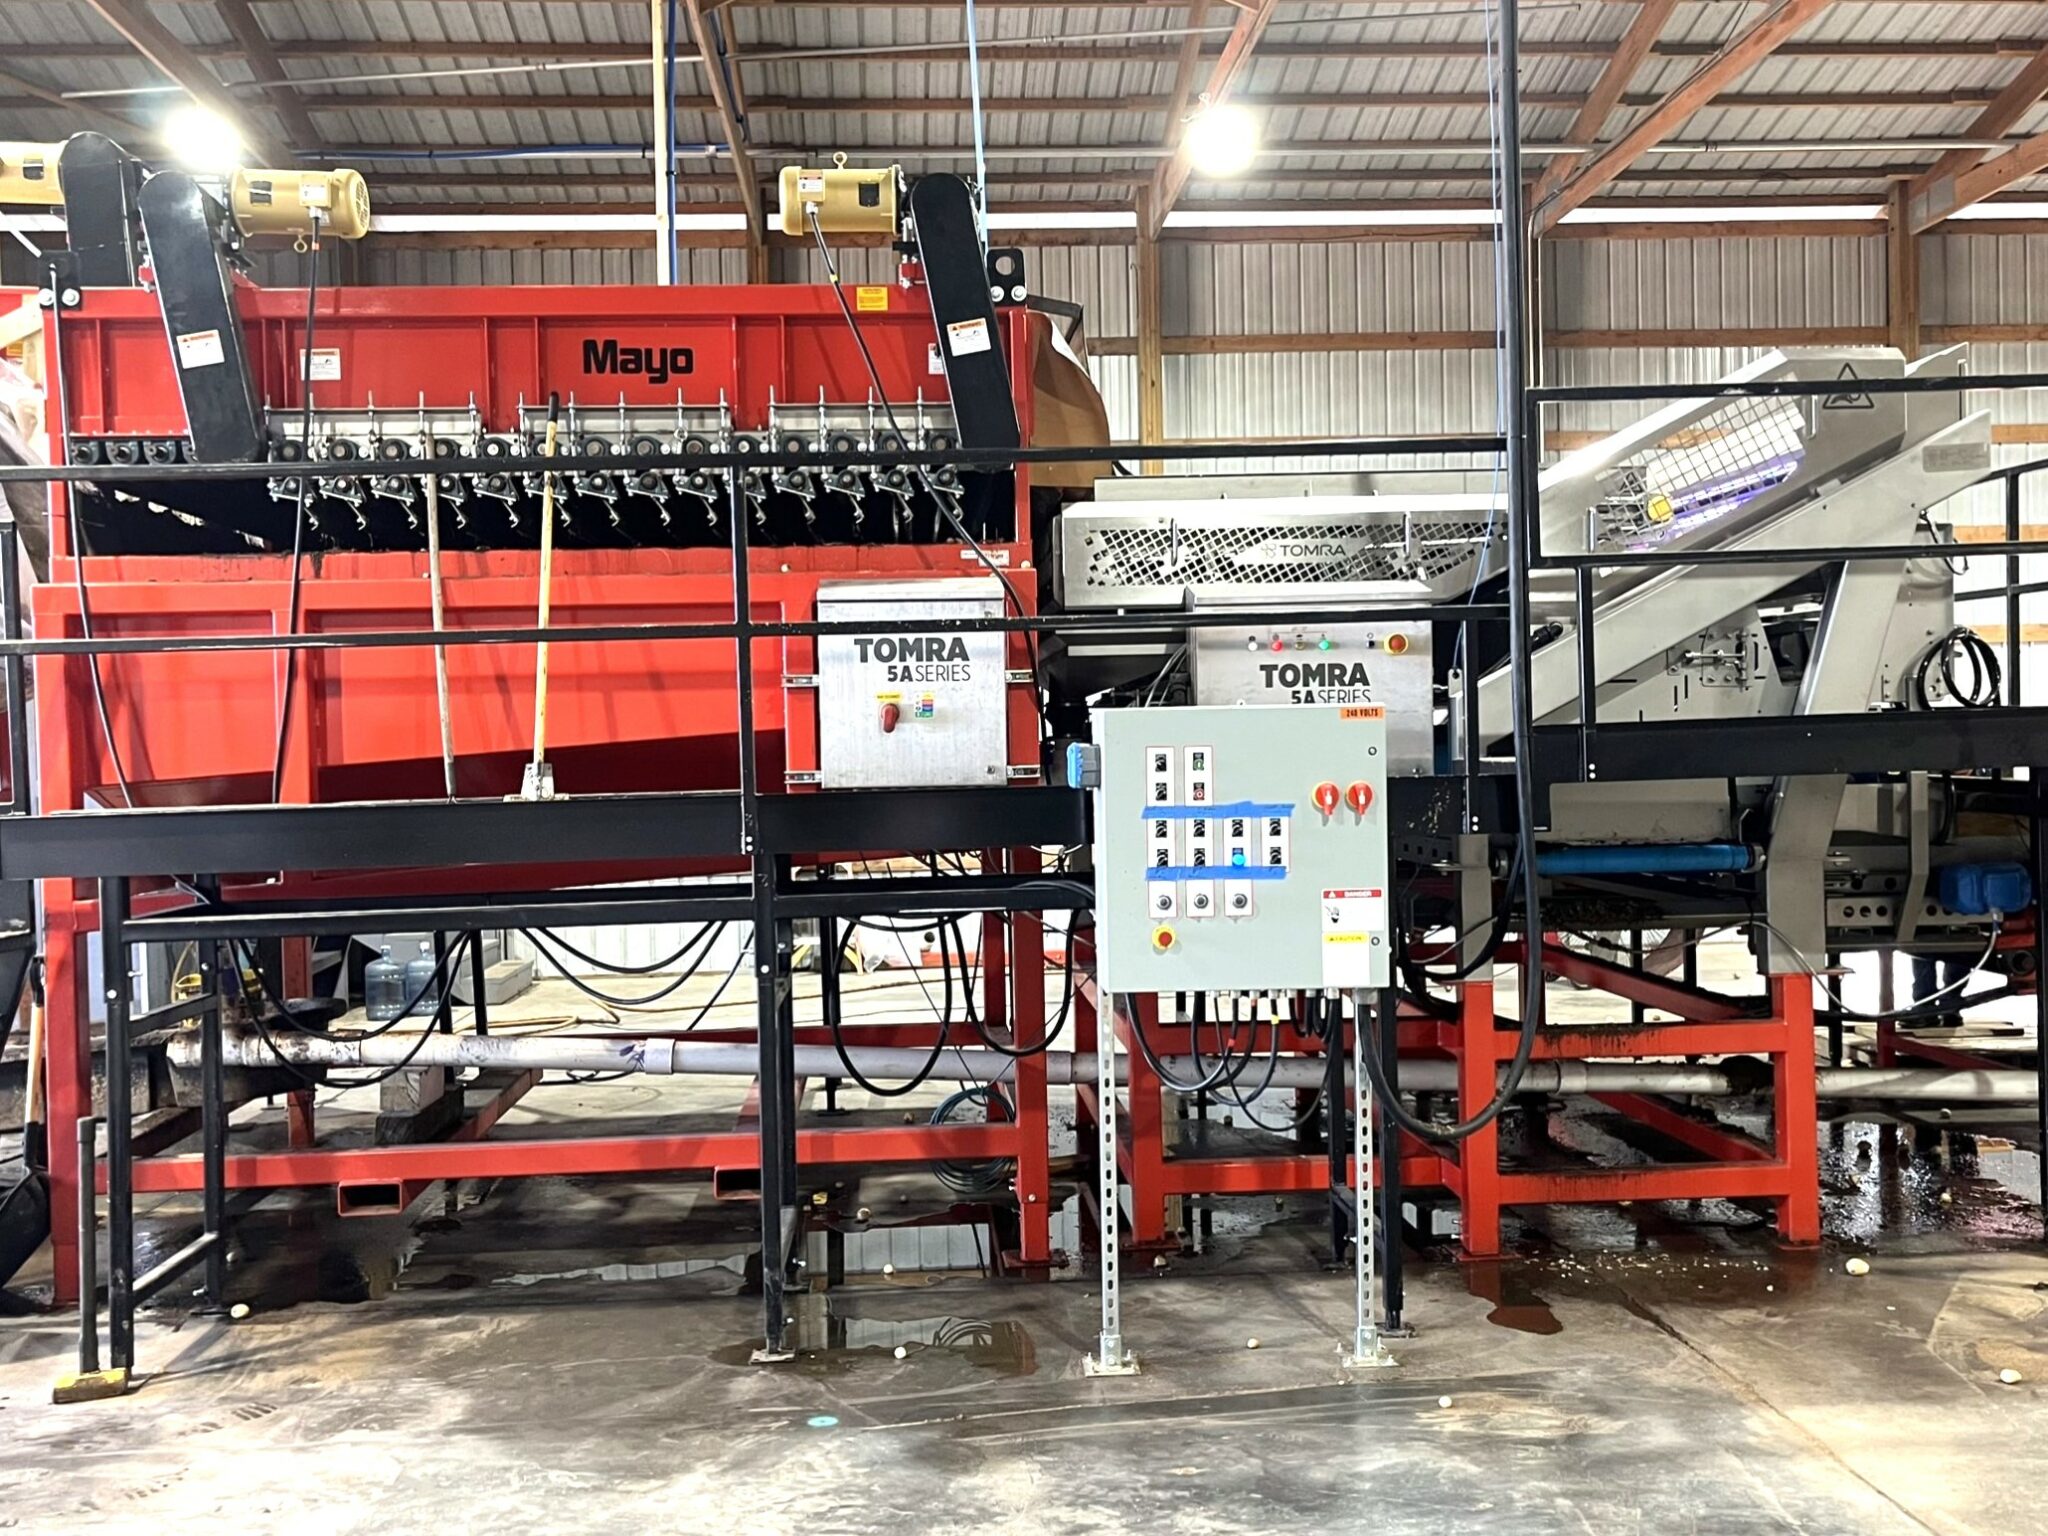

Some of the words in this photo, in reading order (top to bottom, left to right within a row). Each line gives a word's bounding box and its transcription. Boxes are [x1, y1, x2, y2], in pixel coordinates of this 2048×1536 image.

[582, 338, 694, 385] Mayo
[1279, 543, 1346, 557] TOMRA
[853, 636, 970, 663] TOMRA
[1259, 662, 1371, 688] TOMRA
[1359, 708, 1378, 717] VOLTS
